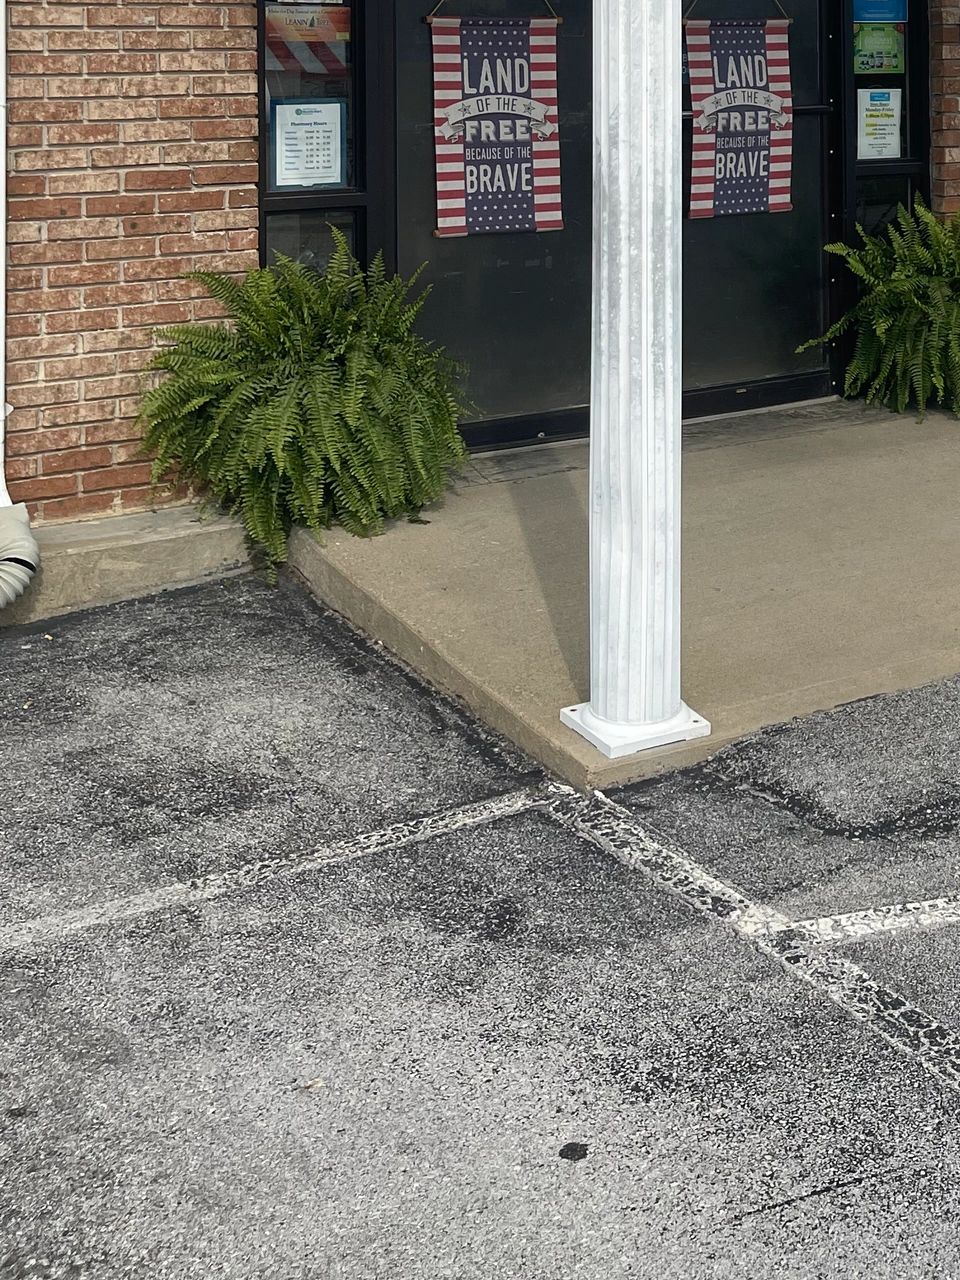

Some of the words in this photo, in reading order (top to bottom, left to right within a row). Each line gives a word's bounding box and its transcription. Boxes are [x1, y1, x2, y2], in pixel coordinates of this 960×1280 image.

[463, 58, 529, 94] LAND
[713, 54, 768, 88] LAND
[476, 97, 491, 113] OF
[495, 96, 518, 112] THE
[725, 91, 738, 105] OF
[742, 91, 759, 104] THE
[465, 119, 531, 142] FREE
[717, 111, 769, 132] FREE
[465, 147, 502, 160] BECAUSE
[504, 147, 515, 159] OF
[517, 146, 531, 159] THE
[716, 137, 746, 149] BECAUSE
[747, 136, 756, 148] OF
[758, 135, 769, 147] THE
[716, 150, 769, 179] BRAVE
[466, 163, 532, 194] BRAVE
